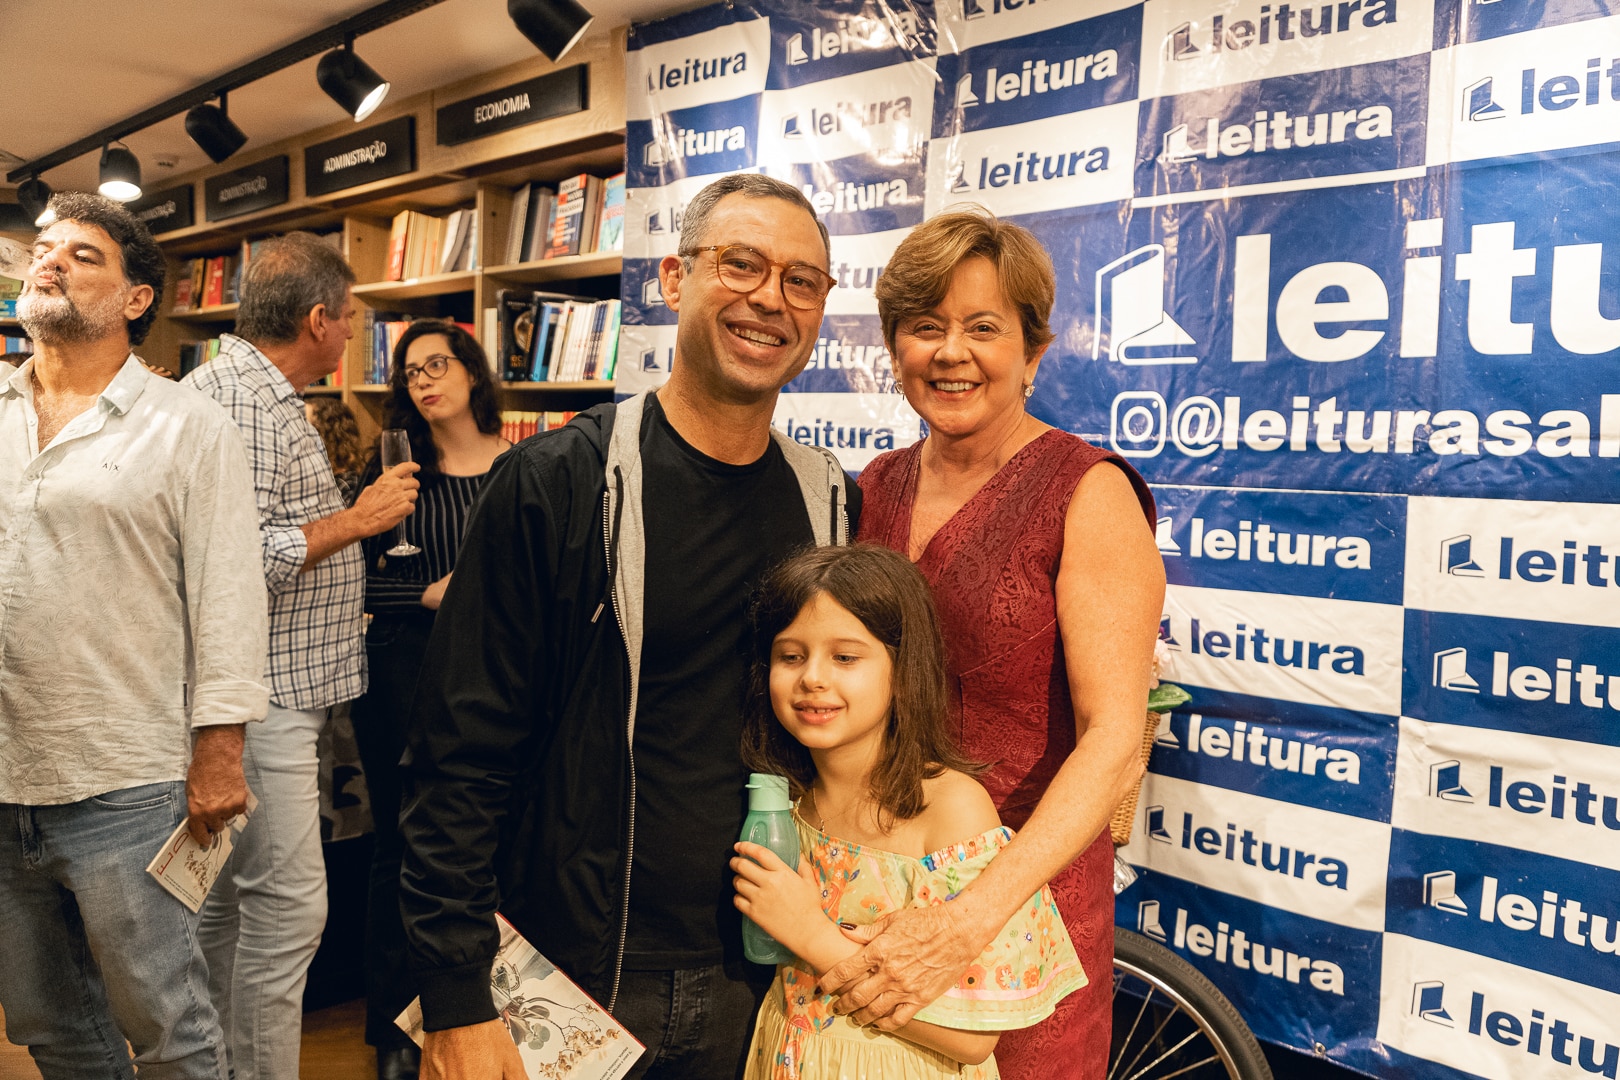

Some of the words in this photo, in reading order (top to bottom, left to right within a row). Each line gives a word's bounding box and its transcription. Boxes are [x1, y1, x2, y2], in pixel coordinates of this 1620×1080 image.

[811, 10, 917, 61] leita
[1212, 0, 1398, 54] leitura
[659, 51, 747, 91] leitura
[985, 48, 1119, 105] leitura
[473, 92, 531, 124] ECONOMIA
[1205, 104, 1393, 159] leitura
[322, 140, 388, 174] ADMINISTRAÇÃO
[666, 125, 746, 161] itura
[978, 146, 1110, 190] leitura
[787, 418, 894, 451] leitura
[1171, 393, 1620, 458] @leiturasal
[1189, 517, 1372, 570] leitura
[1498, 536, 1620, 588] leit
[1190, 617, 1366, 676] leitura
[1188, 714, 1361, 785] leitura
[1181, 812, 1349, 891] leitura
[1479, 875, 1620, 957] leitu
[1174, 907, 1345, 996] leitura
[1468, 991, 1620, 1080] leitu
